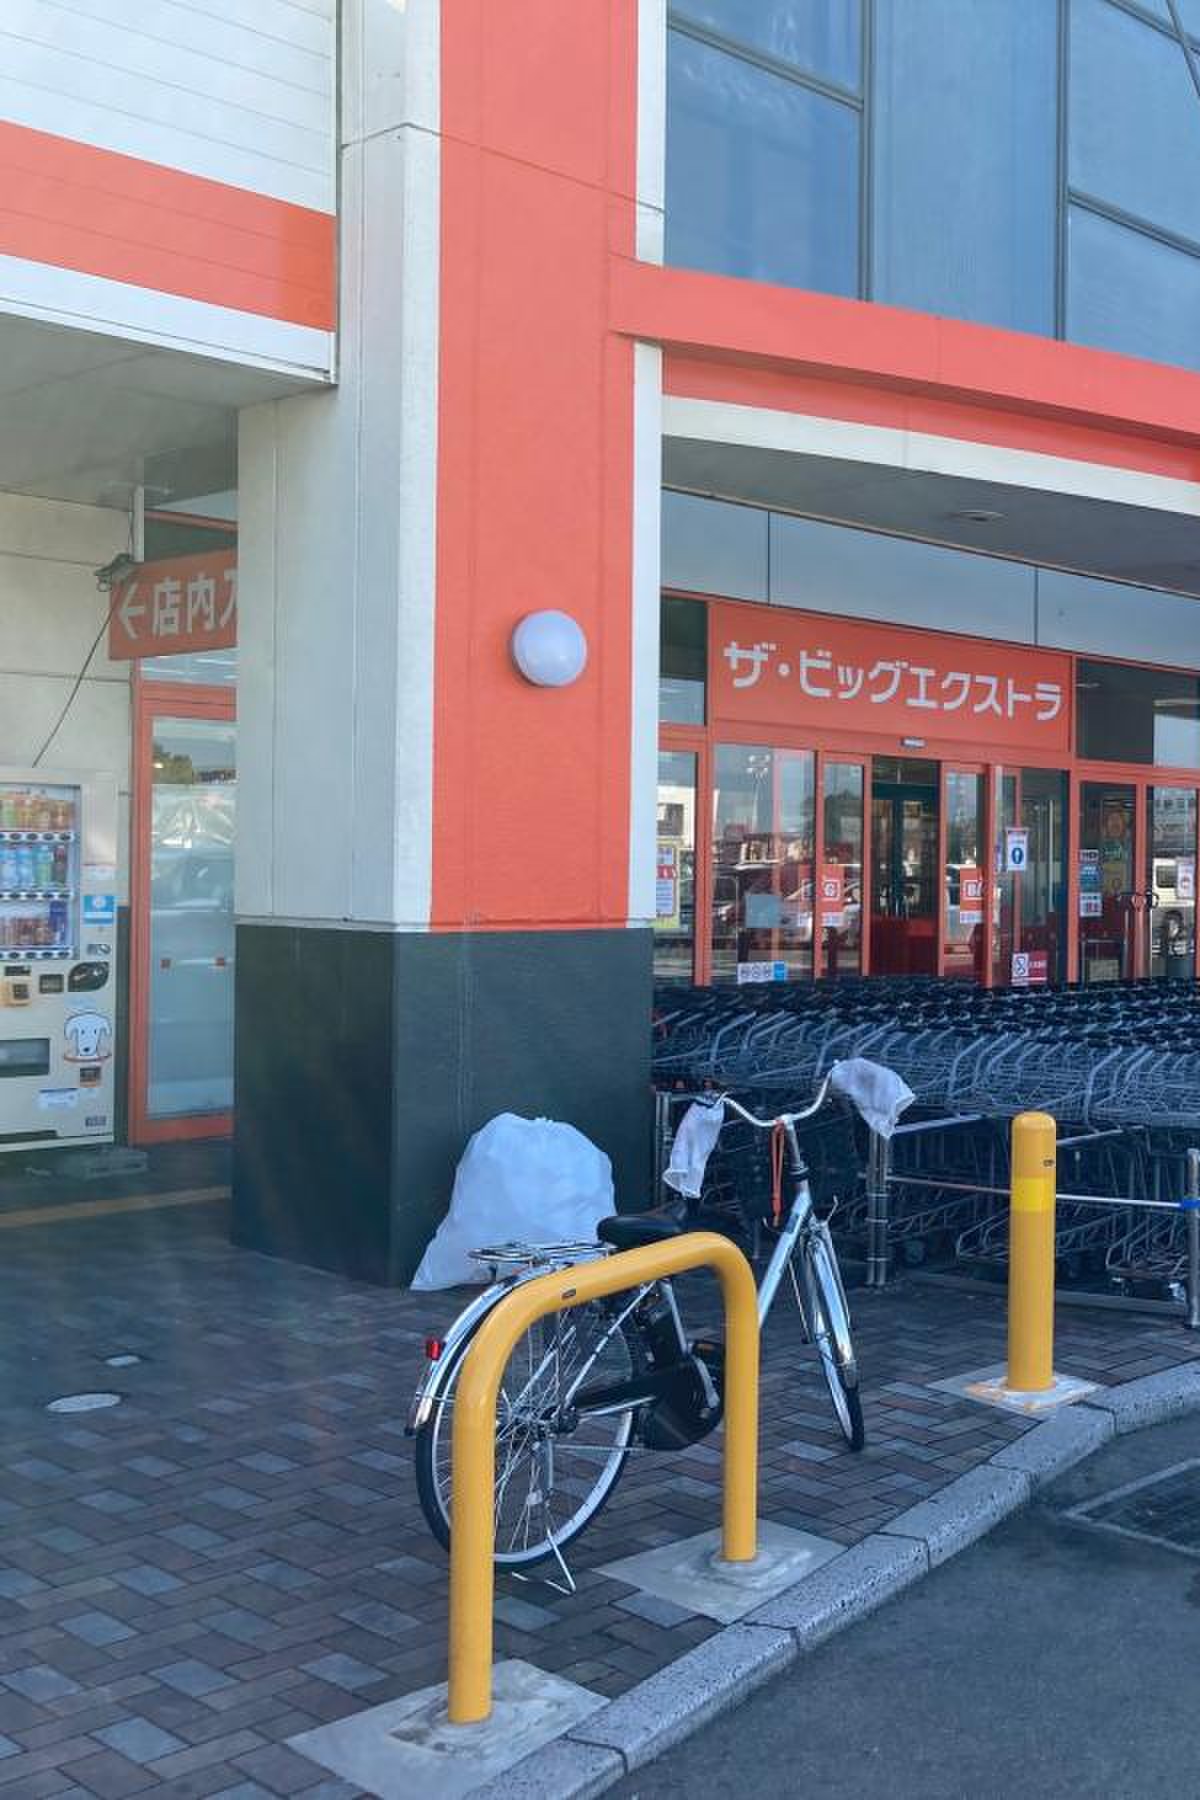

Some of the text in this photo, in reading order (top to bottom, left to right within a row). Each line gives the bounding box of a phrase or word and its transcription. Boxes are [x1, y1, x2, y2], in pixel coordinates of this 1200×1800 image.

[723, 640, 1064, 721] ザ・ビッグエクストラ
